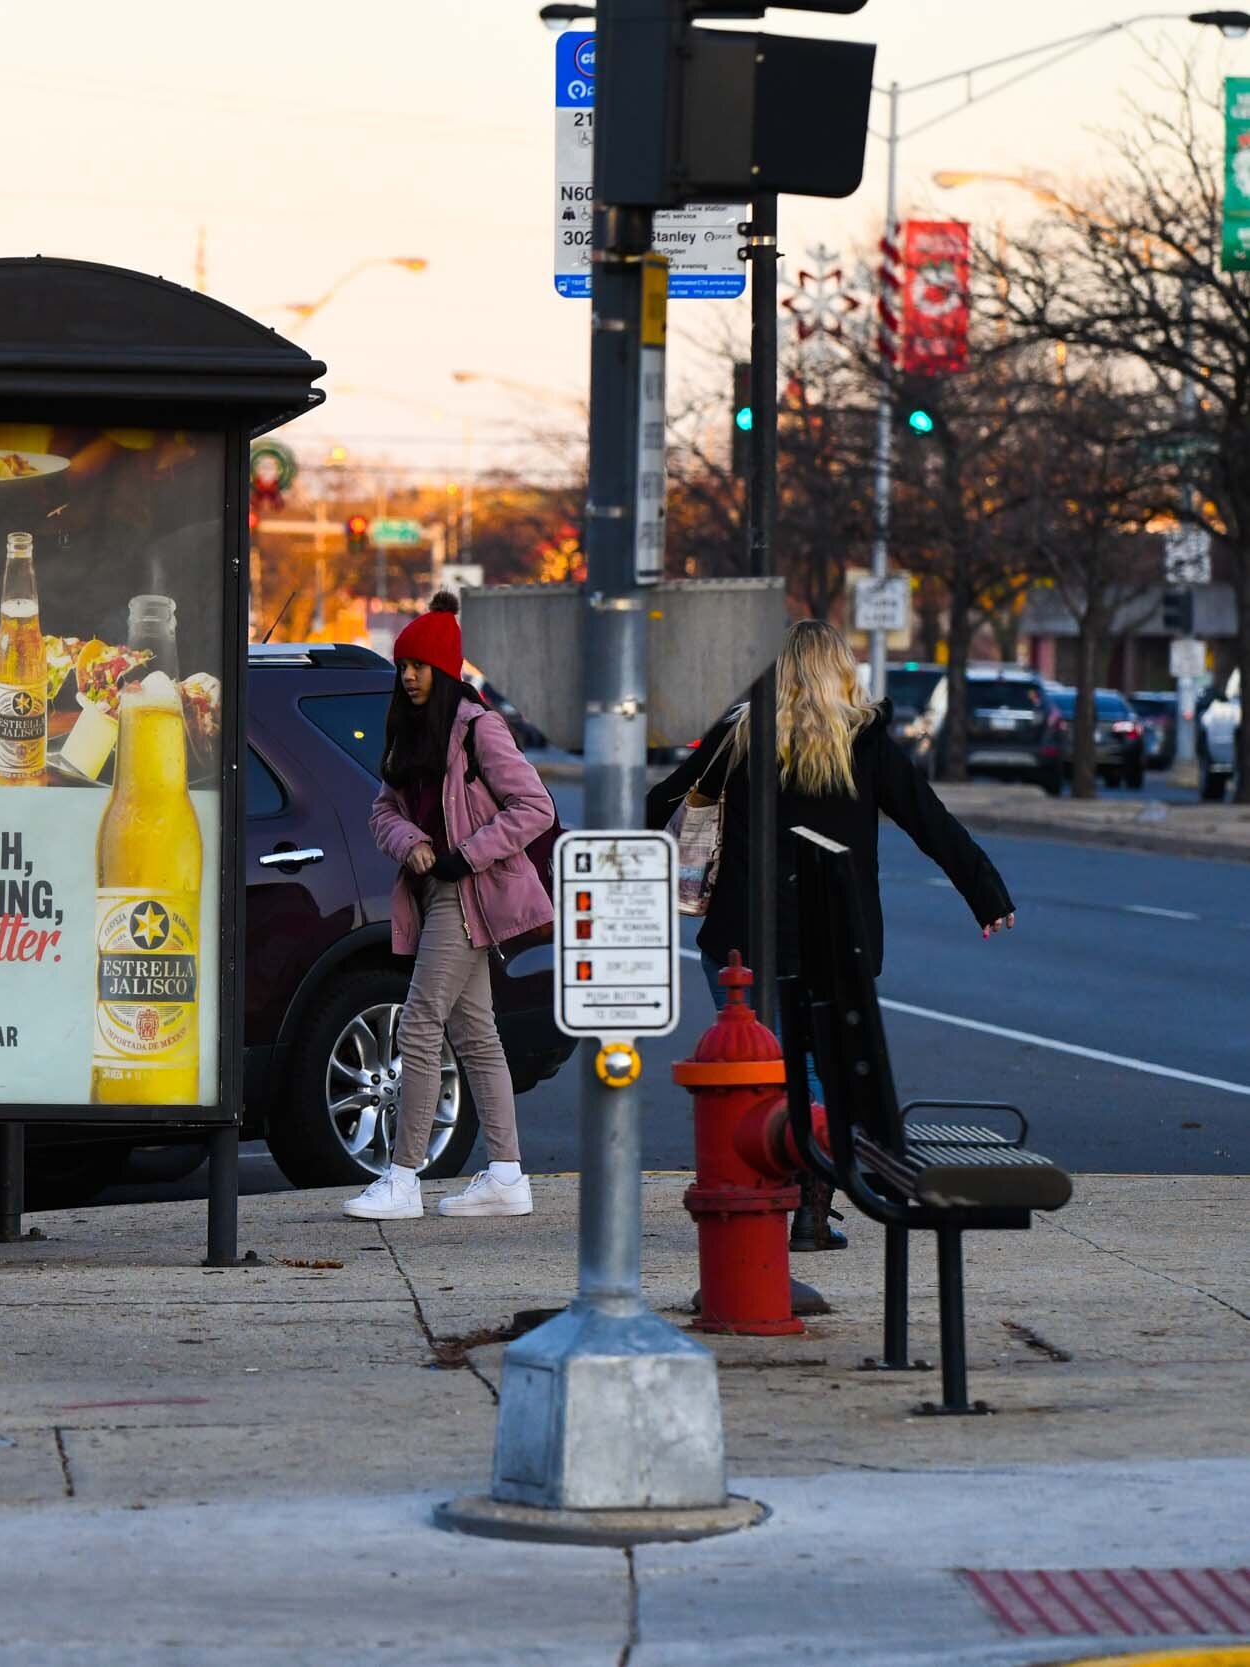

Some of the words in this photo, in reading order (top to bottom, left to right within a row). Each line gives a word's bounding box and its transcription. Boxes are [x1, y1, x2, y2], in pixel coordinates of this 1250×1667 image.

[573, 112, 593, 127] 21
[561, 185, 595, 201] N60
[563, 230, 594, 246] 302
[649, 230, 696, 245] Stanley
[1, 727, 42, 738] JALISCO
[102, 959, 195, 978] ESTRELLA
[109, 977, 188, 996] JALISCO
[106, 1028, 147, 1050] IMPORTADA
[148, 1042, 159, 1051] DE
